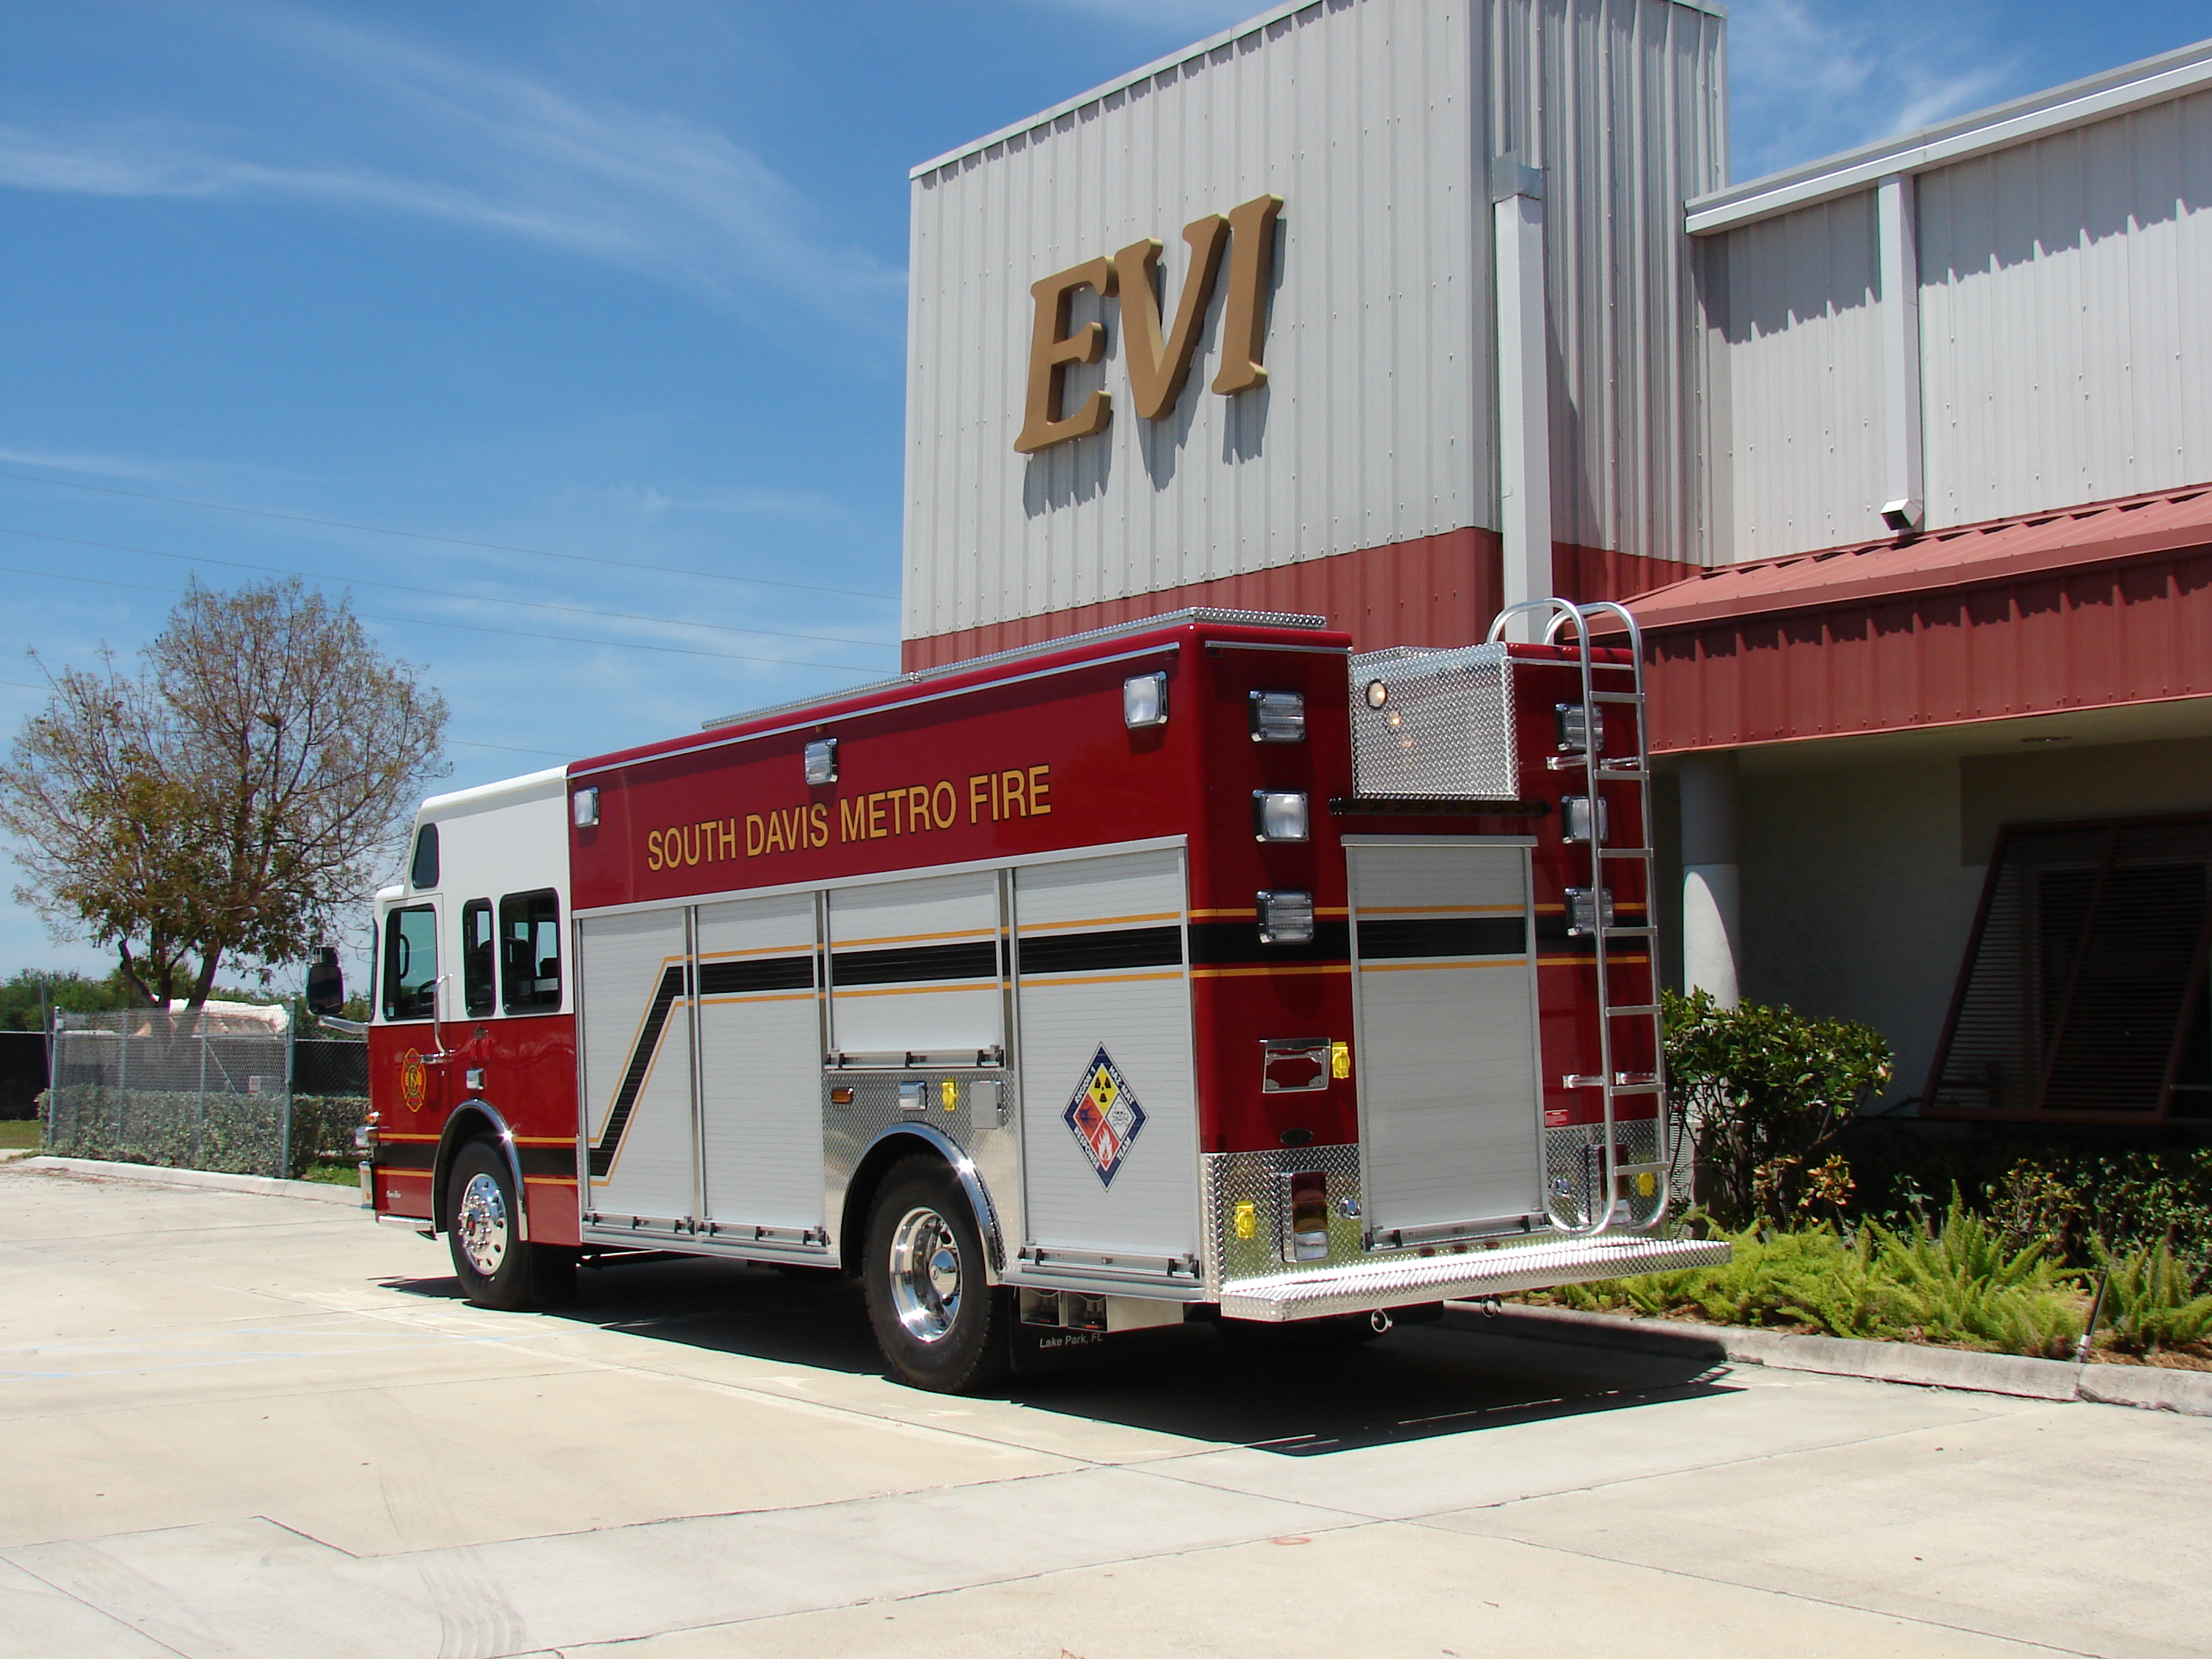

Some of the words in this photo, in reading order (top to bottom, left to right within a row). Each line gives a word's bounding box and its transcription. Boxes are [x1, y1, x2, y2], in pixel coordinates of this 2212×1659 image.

[1014, 194, 1284, 454] EVI
[648, 819, 736, 872] SOUTH
[745, 803, 829, 858] DAVIS
[840, 781, 957, 844] METRO
[969, 764, 1051, 824] FIRE
[1075, 1073, 1092, 1104] REGION
[1073, 1126, 1100, 1170] RESPONSE
[1116, 1136, 1132, 1161] TEAM
[1039, 1337, 1063, 1348] Lake
[1064, 1334, 1089, 1346] Park,
[1091, 1332, 1103, 1342] FL
